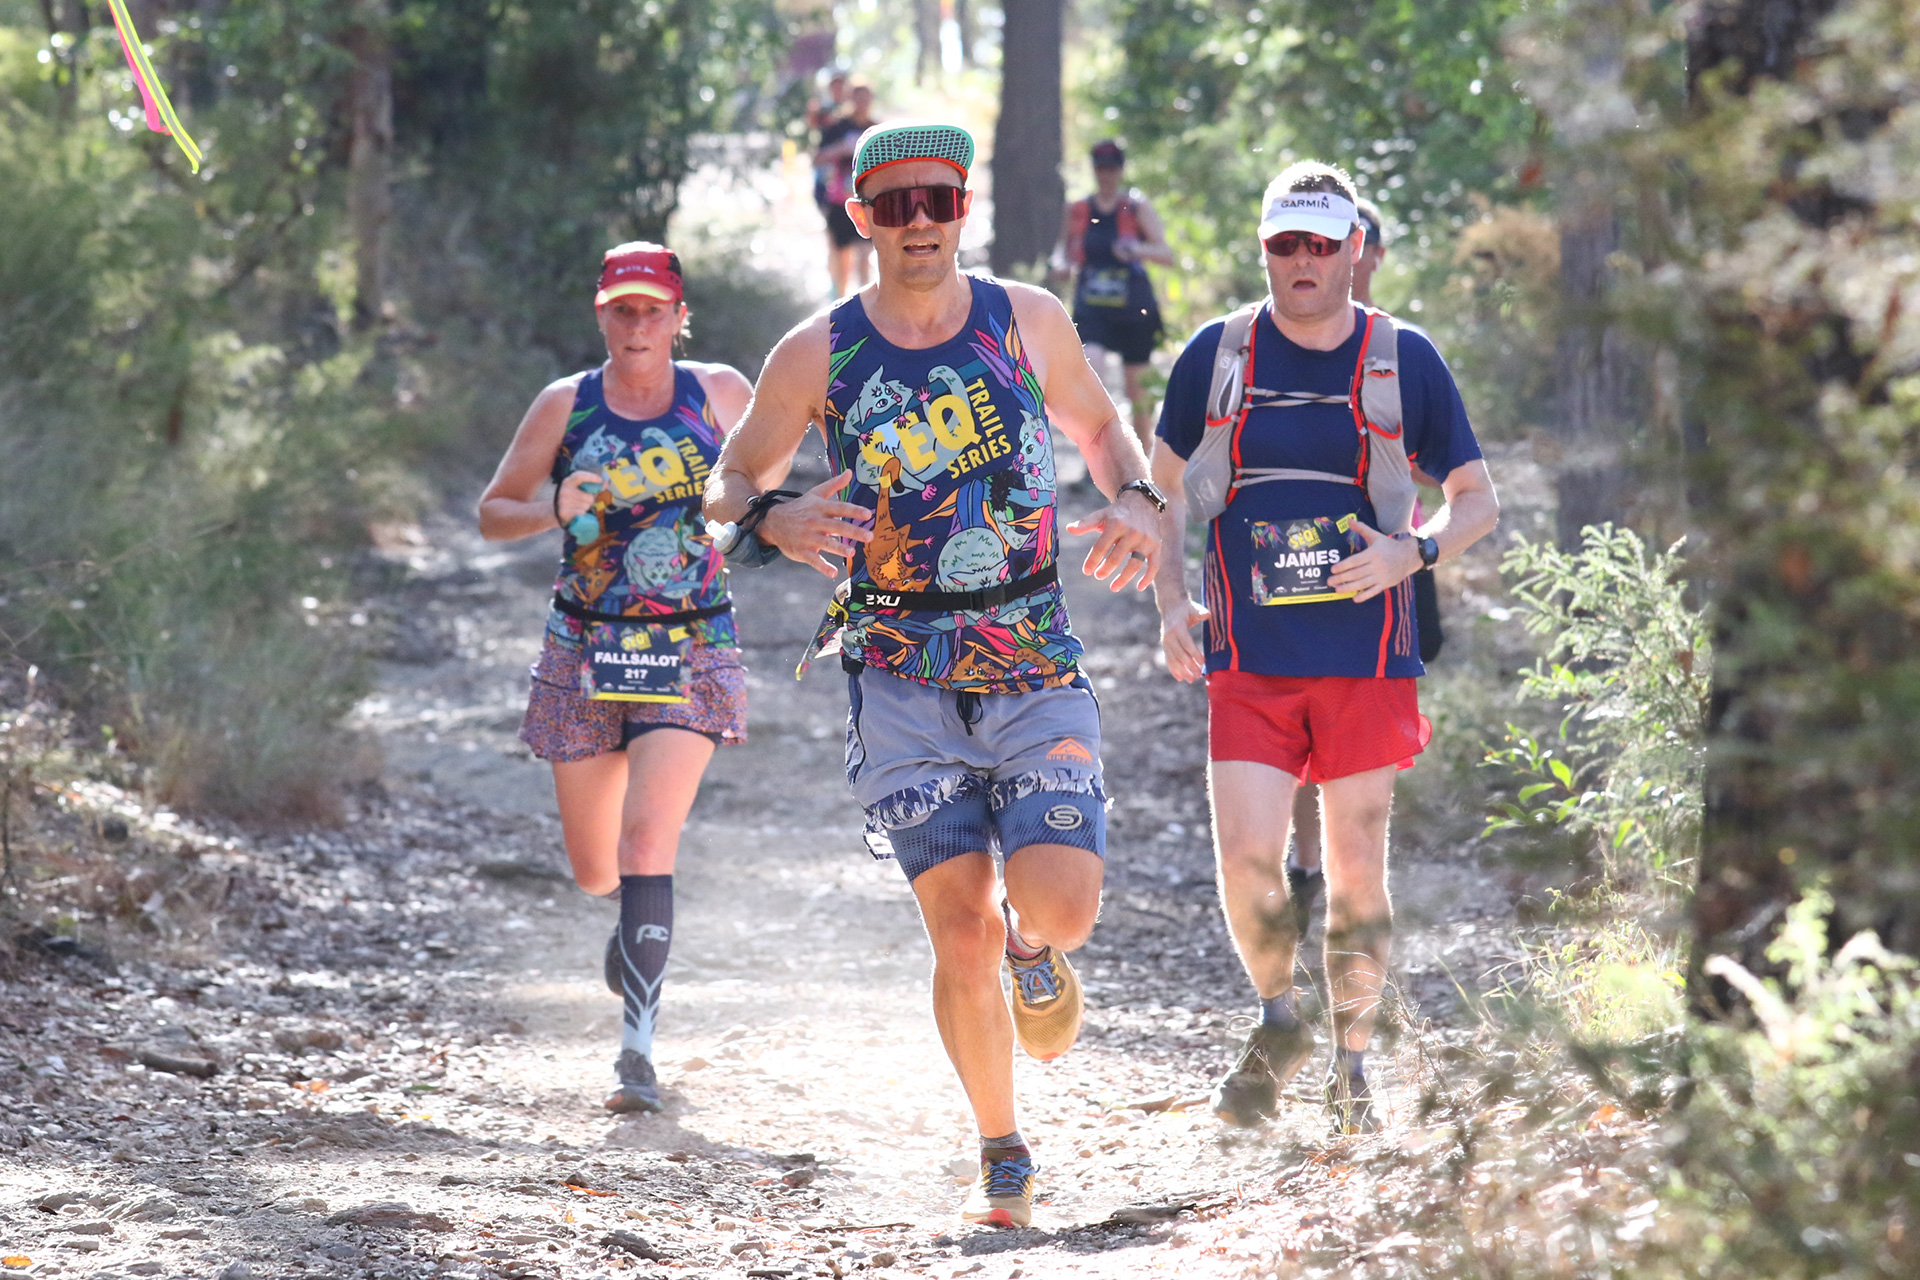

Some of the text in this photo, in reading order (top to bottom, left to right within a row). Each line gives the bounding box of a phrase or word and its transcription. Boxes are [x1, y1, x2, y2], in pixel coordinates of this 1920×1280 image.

[1281, 199, 1330, 210] GARMIN
[965, 377, 1006, 438] TRAIL
[675, 436, 711, 480] TRAIL
[946, 434, 1013, 480] SERIES
[653, 479, 709, 504] SERIE
[1274, 549, 1341, 569] JAMES
[1297, 567, 1321, 579] 140
[594, 652, 680, 667] FALLSALOT
[624, 668, 649, 679] 217
